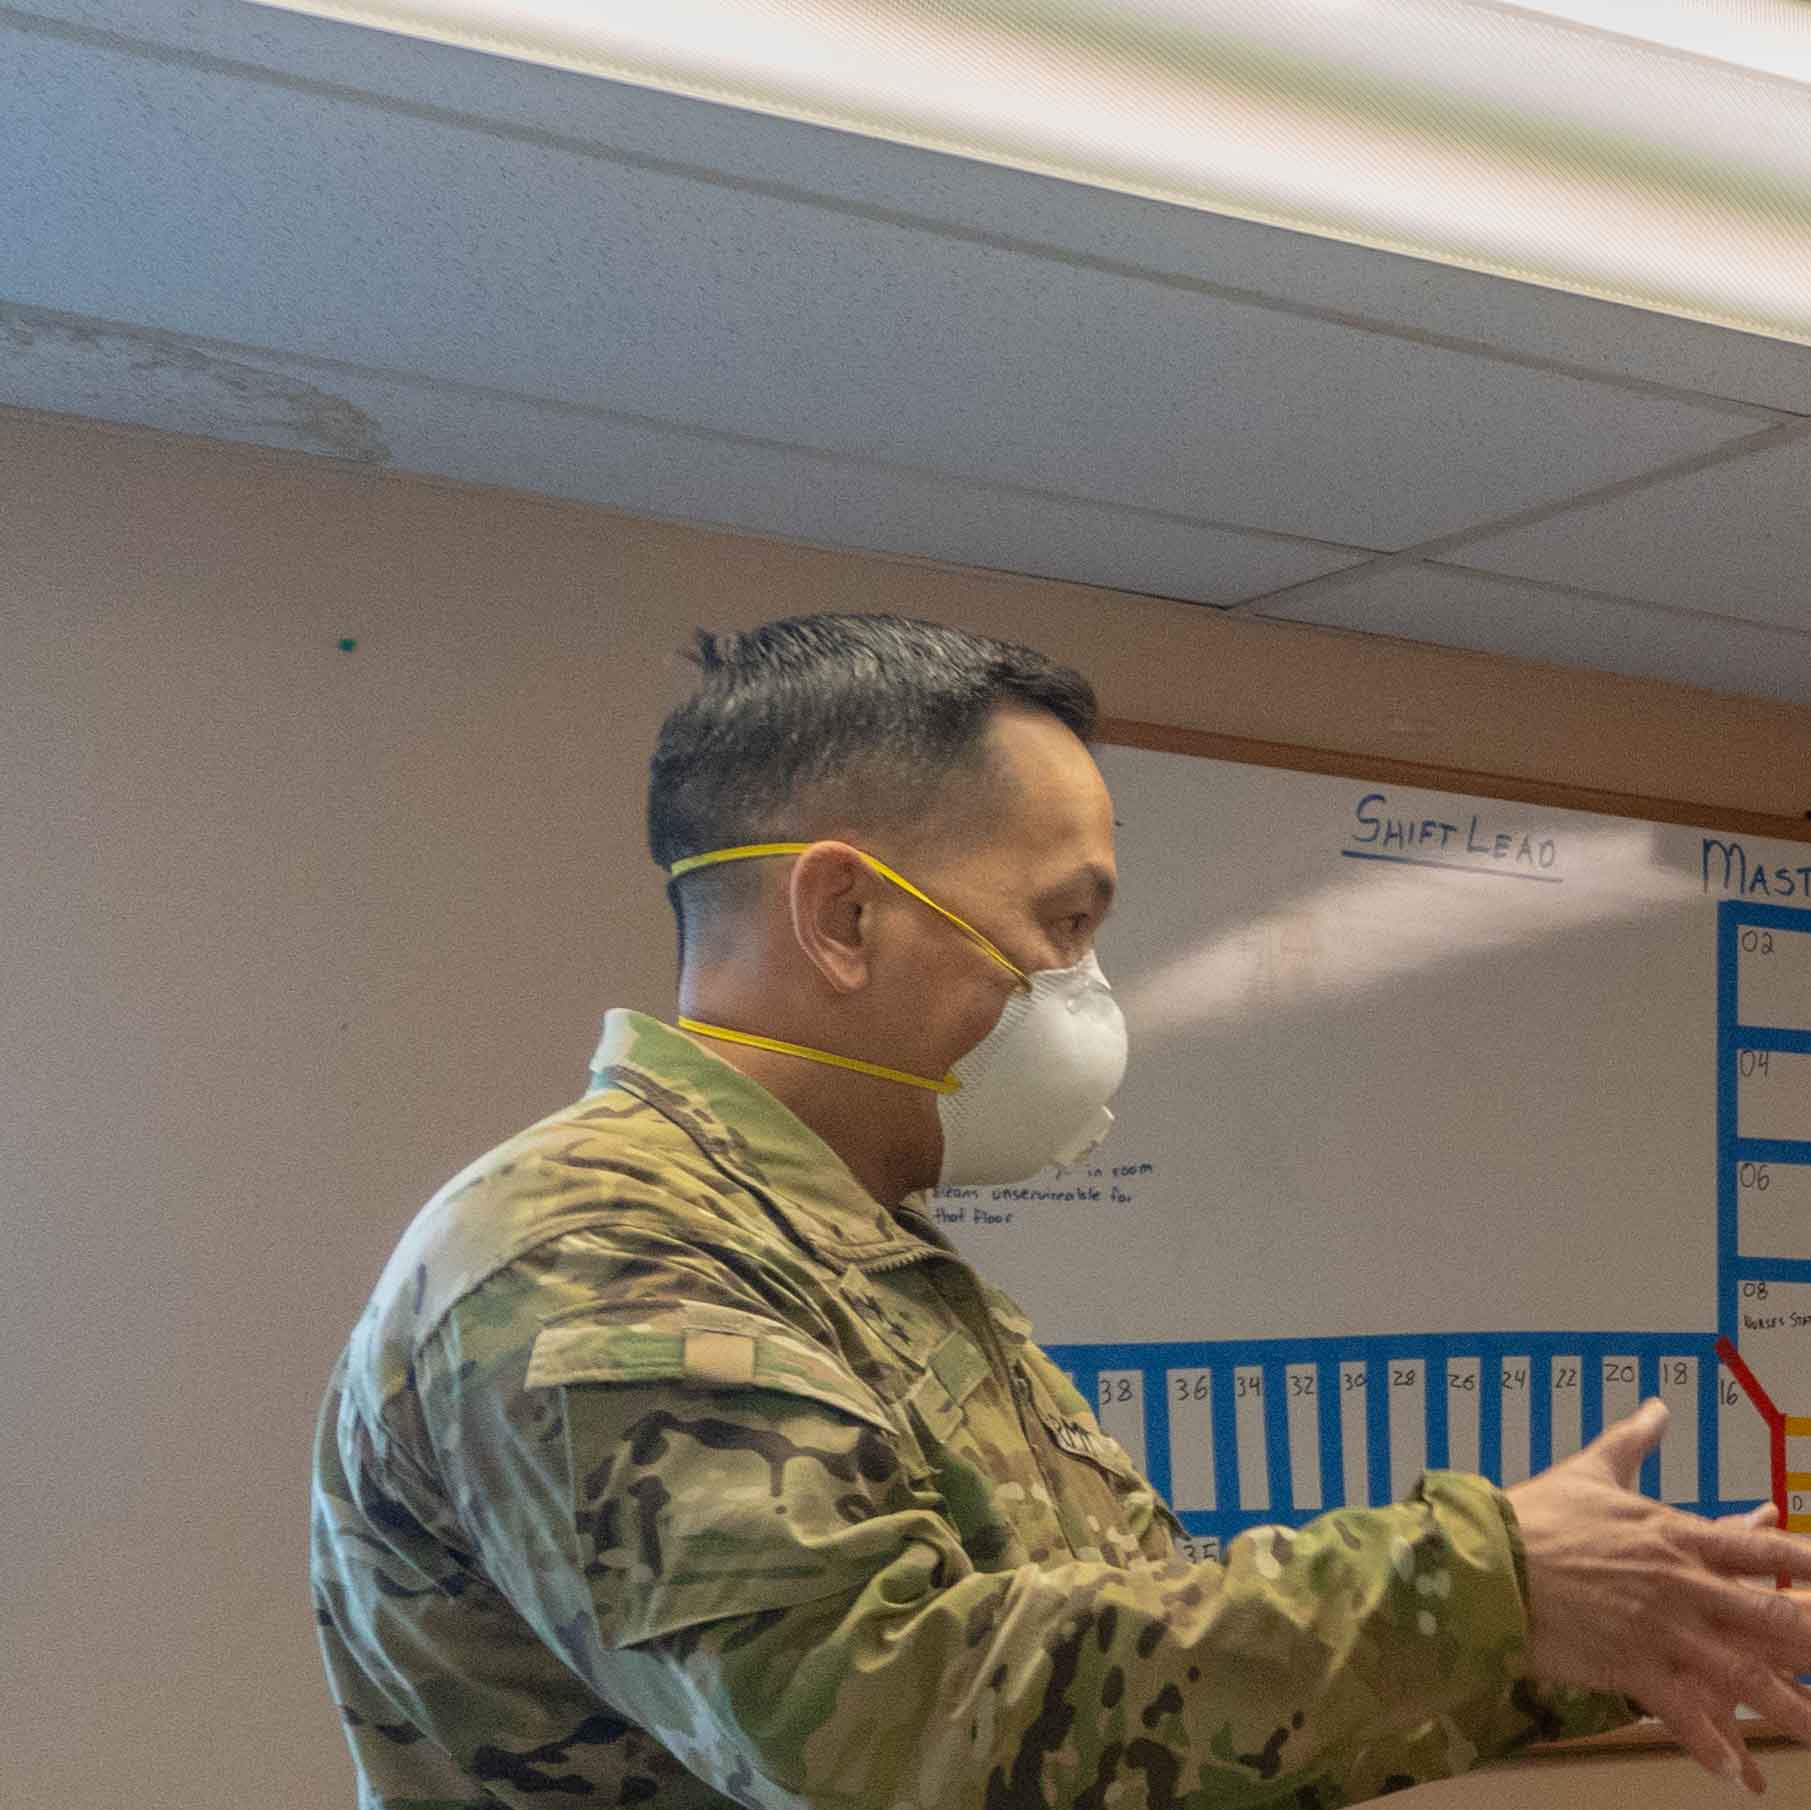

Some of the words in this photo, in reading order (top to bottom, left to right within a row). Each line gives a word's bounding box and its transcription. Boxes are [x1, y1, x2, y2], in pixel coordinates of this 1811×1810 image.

[1353, 796, 1457, 853] SHIFT
[1740, 930, 1775, 956] 02
[1739, 1049, 1771, 1078] 04
[1738, 1163, 1771, 1191] 06
[1743, 1282, 1768, 1300] 08
[1391, 1367, 1416, 1388] 28
[1447, 1366, 1476, 1391] 26
[1500, 1368, 1528, 1392] 24
[1554, 1368, 1578, 1391] 22
[1603, 1362, 1635, 1385] 20
[1661, 1361, 1689, 1386] 18
[1098, 1379, 1134, 1405] 38
[1174, 1375, 1209, 1401] 36
[1235, 1378, 1261, 1401] 34
[1289, 1375, 1317, 1399] 32
[1342, 1374, 1368, 1399] 30
[1718, 1378, 1739, 1406] 16
